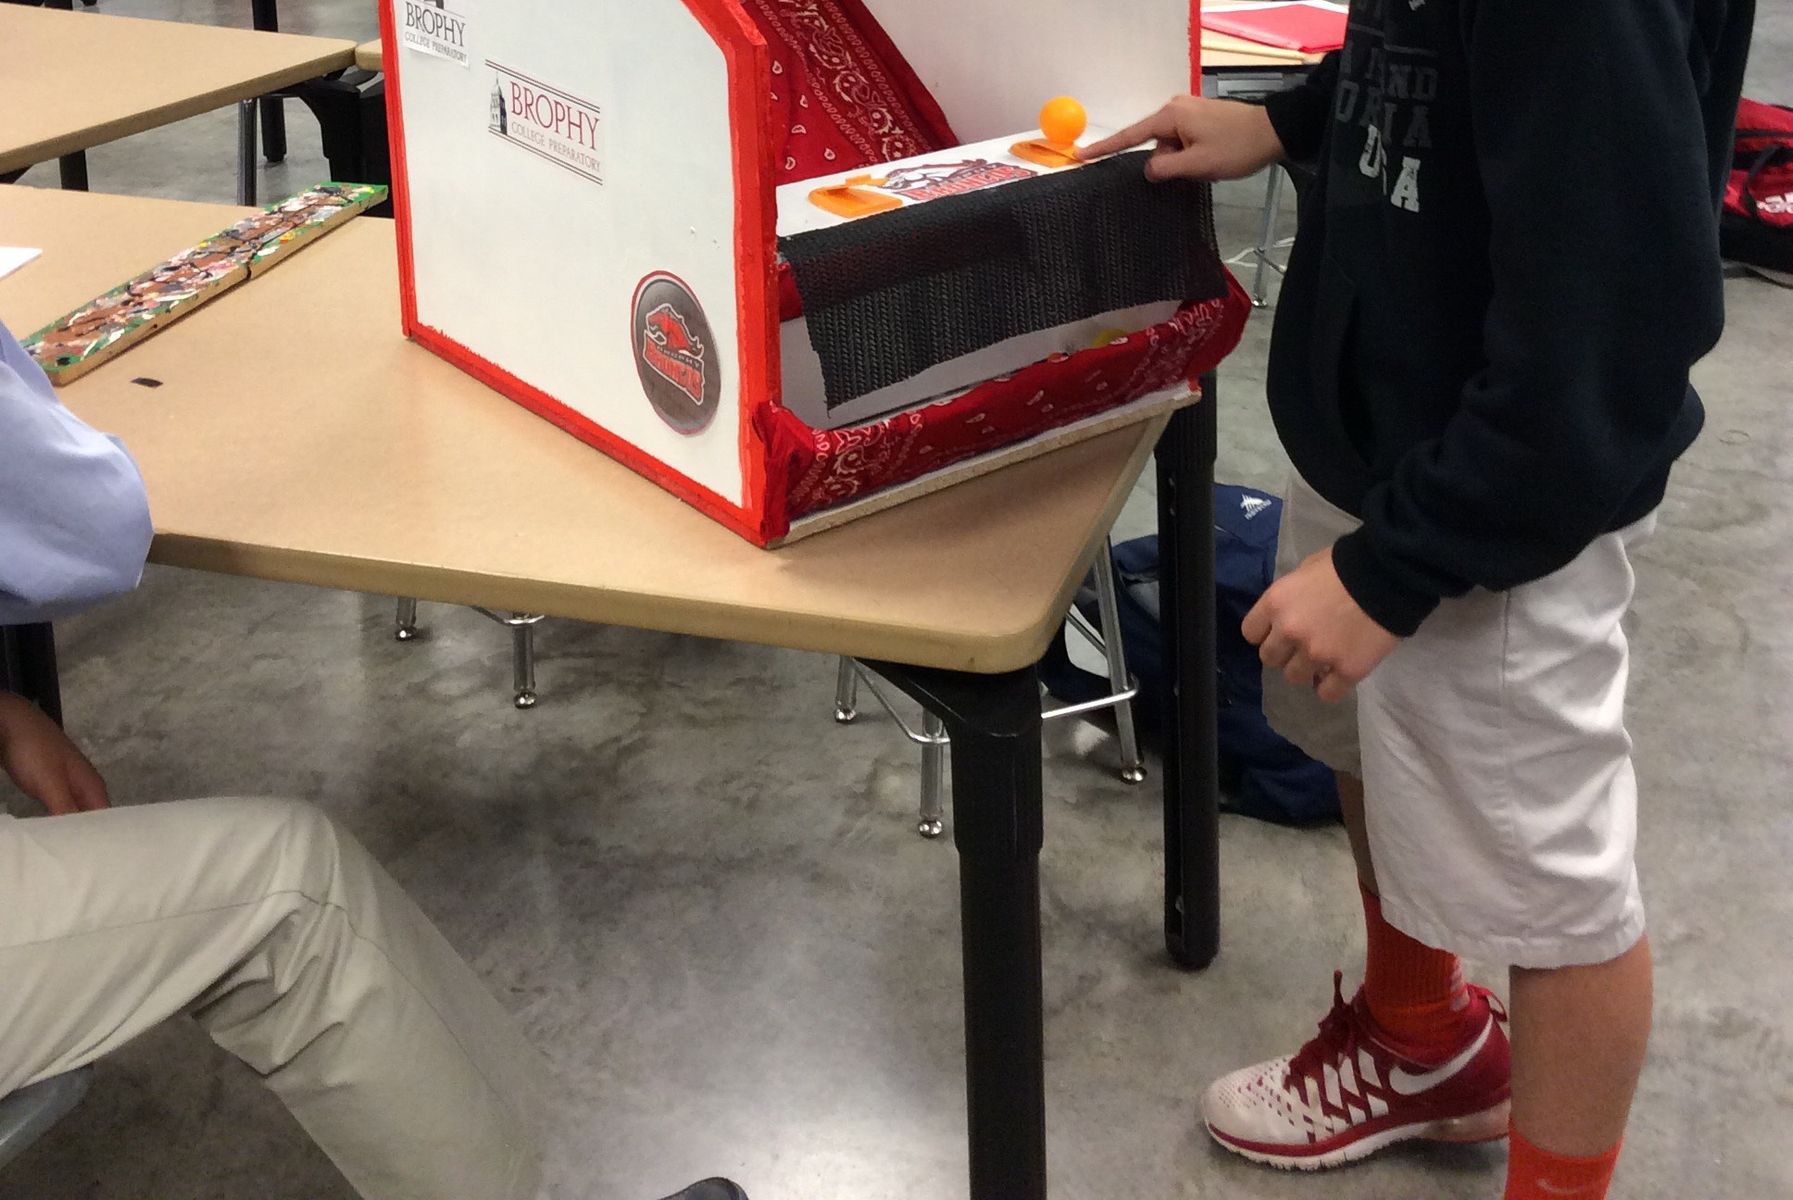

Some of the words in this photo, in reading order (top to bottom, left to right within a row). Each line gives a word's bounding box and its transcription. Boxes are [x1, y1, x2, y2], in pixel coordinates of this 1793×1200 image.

[406, 1, 466, 47] BROPHY
[510, 81, 600, 151] BROPHY
[511, 121, 546, 147] COLLEGE
[549, 138, 601, 172] PREPARATORY
